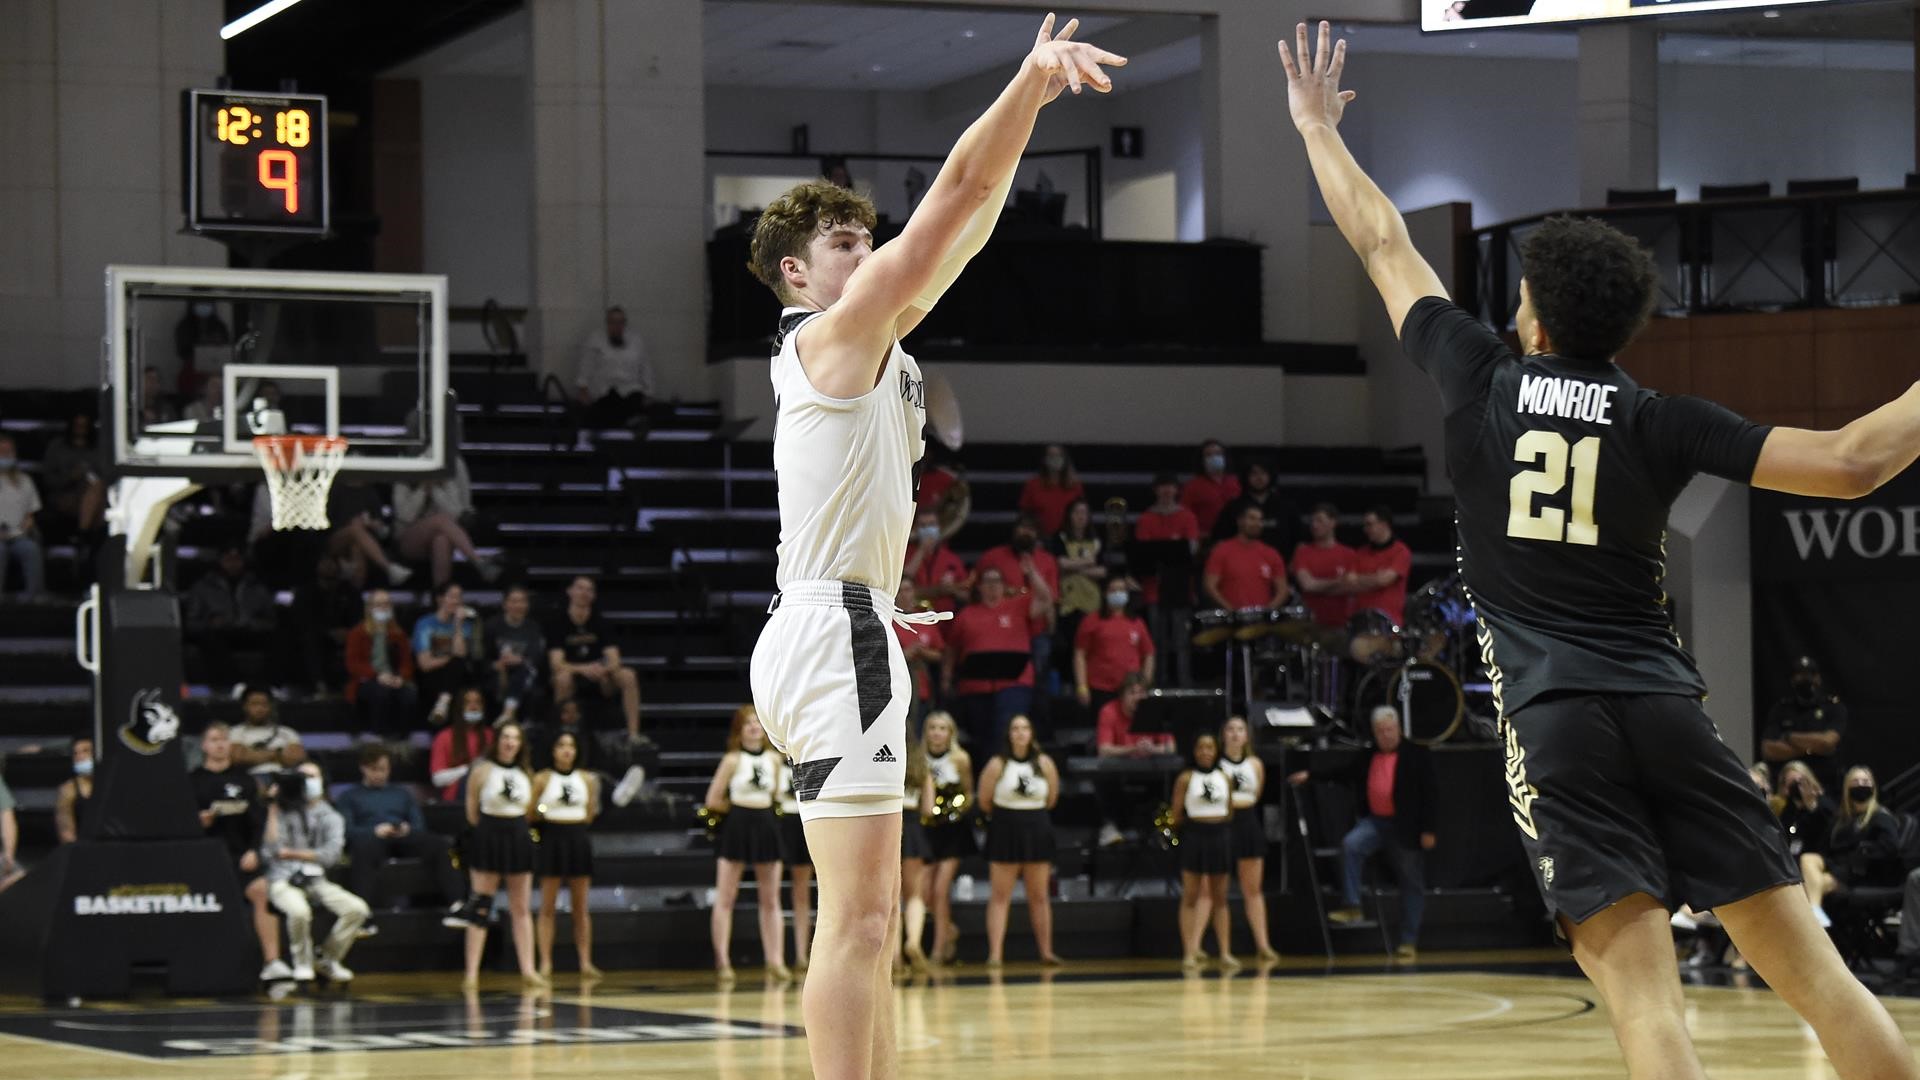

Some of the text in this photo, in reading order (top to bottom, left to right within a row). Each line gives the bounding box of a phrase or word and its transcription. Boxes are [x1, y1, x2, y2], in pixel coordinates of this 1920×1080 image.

[217, 106, 310, 148] 12:18
[258, 149, 298, 214] 9
[1516, 373, 1619, 426] MONROE
[1506, 429, 1601, 547] 21
[74, 892, 223, 915] BASKETBALL
